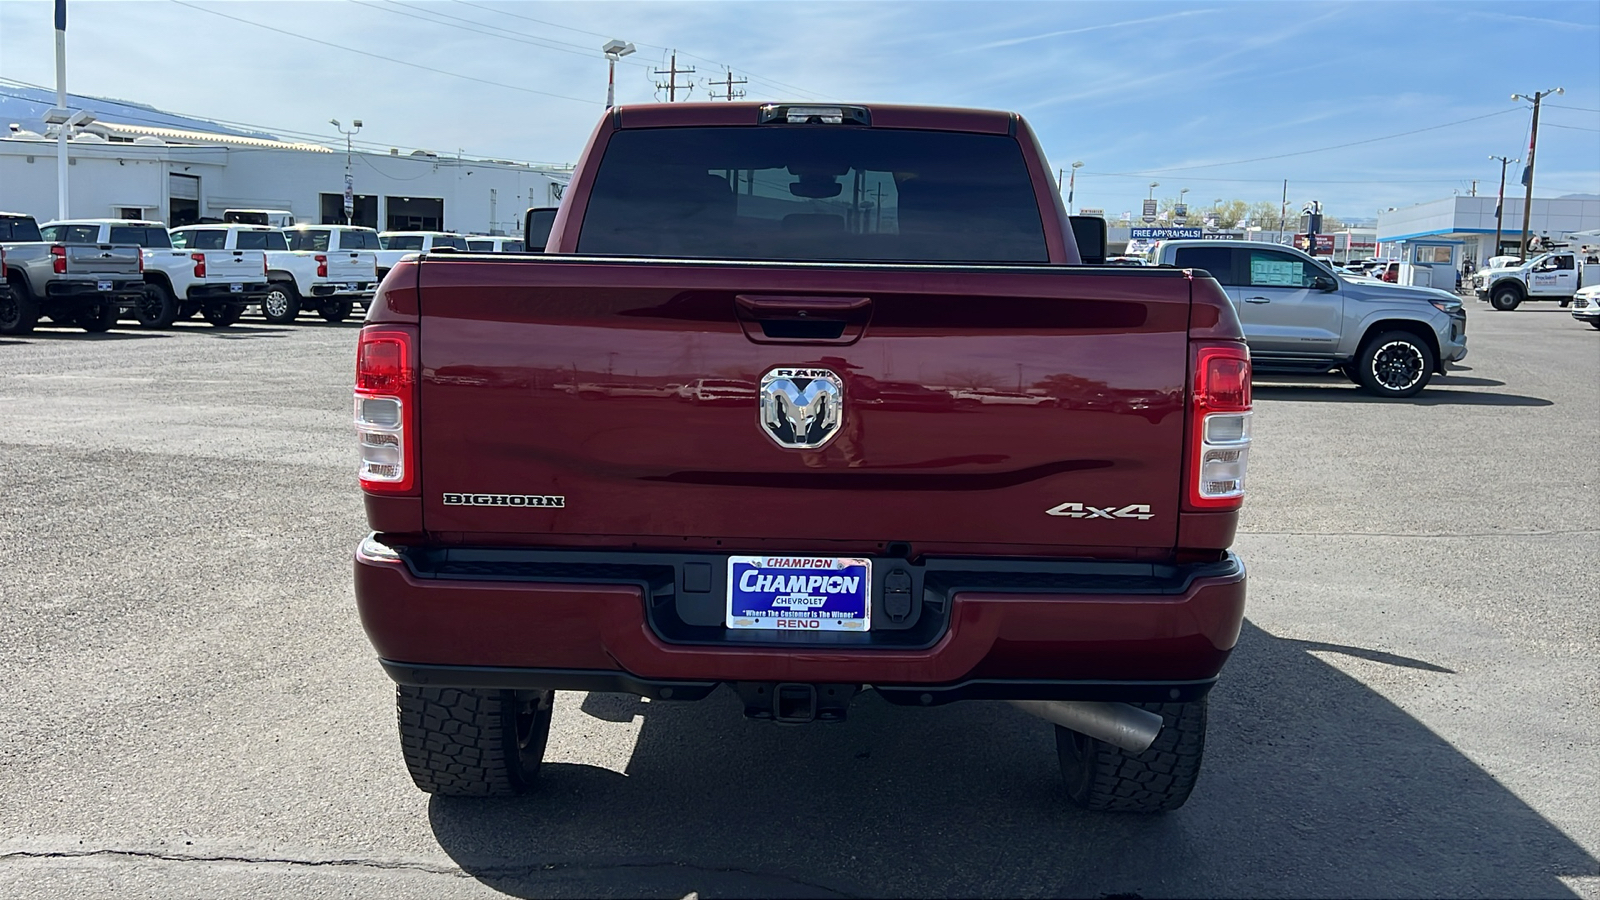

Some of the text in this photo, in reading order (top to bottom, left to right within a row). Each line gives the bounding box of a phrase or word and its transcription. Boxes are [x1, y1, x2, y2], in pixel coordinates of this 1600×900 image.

[1132, 229, 1151, 238] FREE
[443, 493, 565, 508] BIGHORN
[1045, 502, 1155, 520] 4x4
[767, 558, 833, 568] CHAMPION
[739, 569, 860, 594] CHAMPION
[775, 597, 823, 605] CHEVROLET
[780, 610, 810, 618] Customer
[776, 619, 820, 629] RENO
